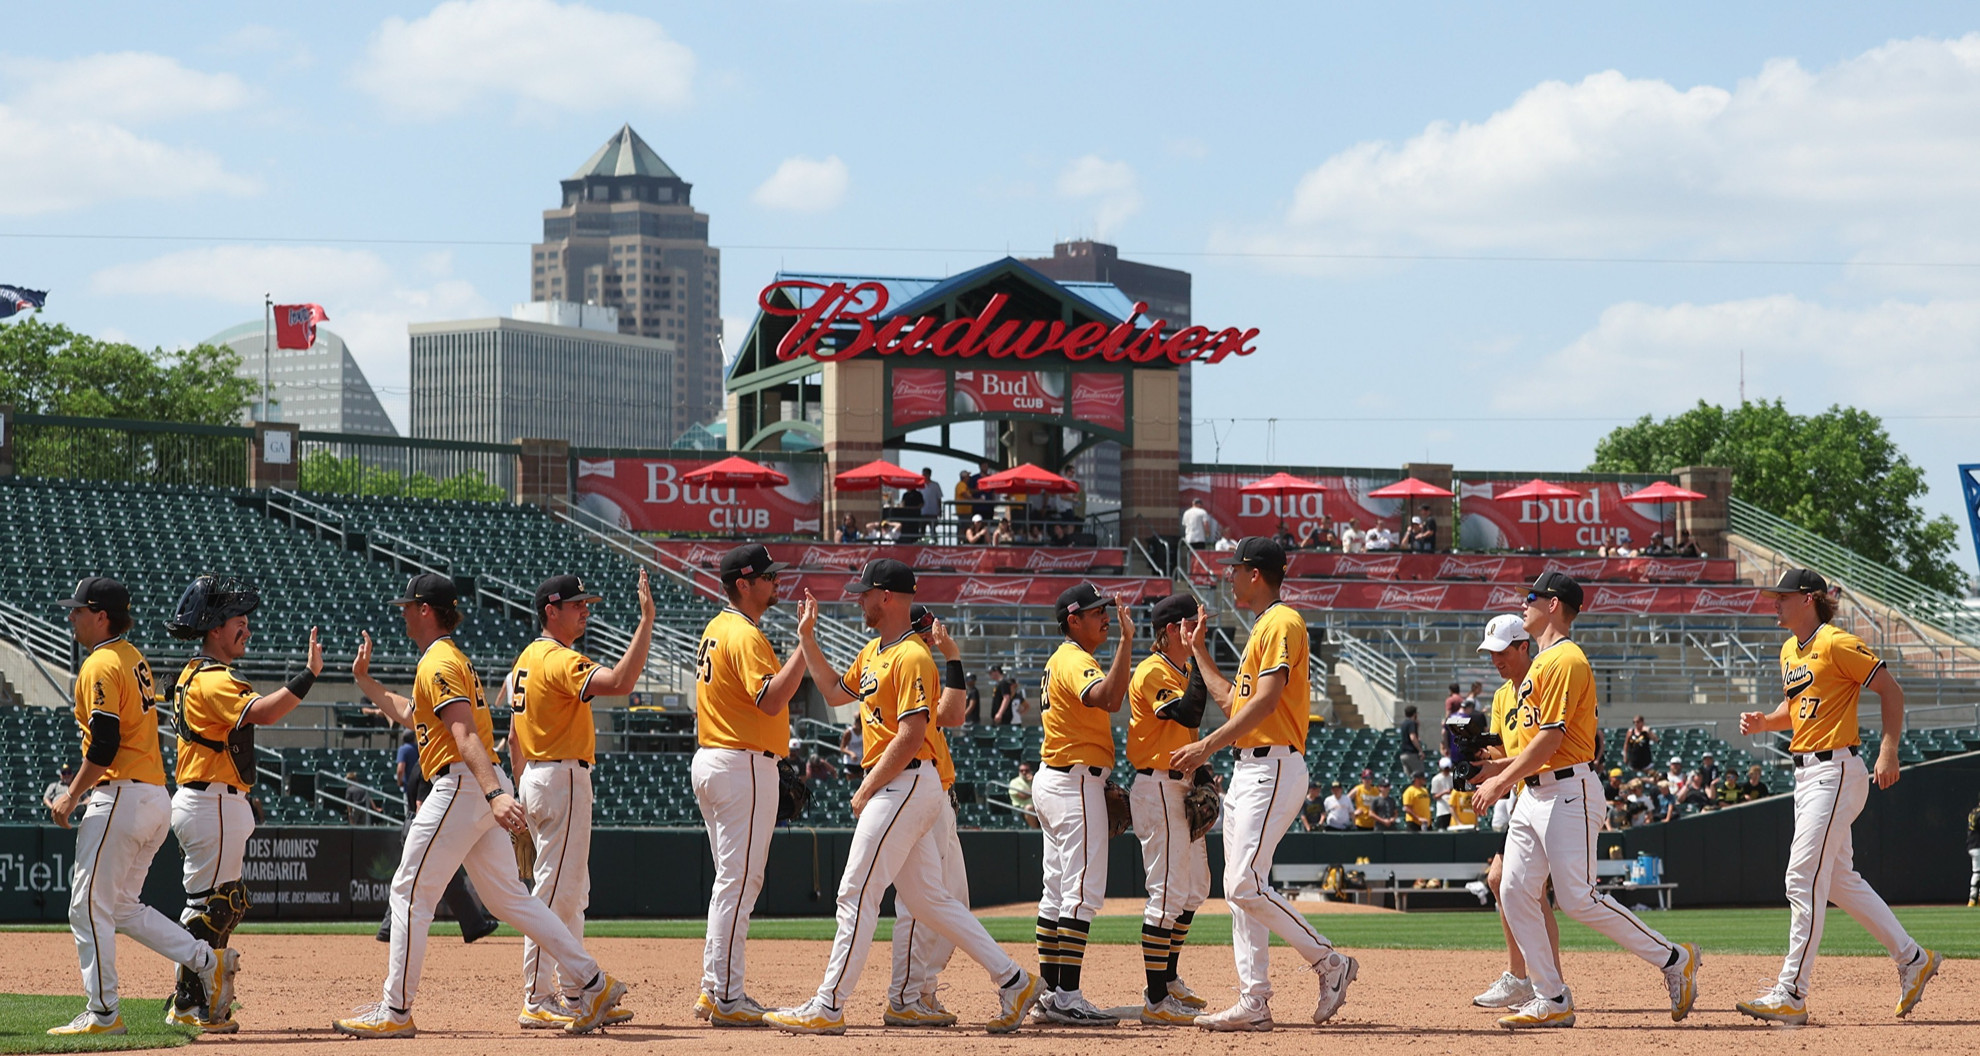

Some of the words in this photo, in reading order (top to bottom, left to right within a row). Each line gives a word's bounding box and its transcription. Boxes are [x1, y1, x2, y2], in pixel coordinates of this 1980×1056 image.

[758, 280, 1260, 364] Budweiser
[981, 373, 1028, 396] Bud
[1012, 397, 1044, 409] CLUB
[270, 441, 286, 454] GA
[708, 507, 771, 529] CLUB
[803, 550, 868, 566] Budweiser
[917, 553, 981, 567] Budweiser
[1027, 555, 1092, 569] Budweiser
[1336, 560, 1397, 574] Budweiser
[1442, 562, 1500, 575] Budweiser
[961, 582, 1027, 597] Budweiser
[1382, 589, 1442, 603] Budweiser
[1594, 591, 1651, 606] Budweiser
[1697, 593, 1753, 608] Budweiser
[1799, 696, 1821, 720] 27
[250, 838, 270, 858] DES
[0, 854, 75, 892] Fiel
[242, 861, 308, 881] MARGARITA
